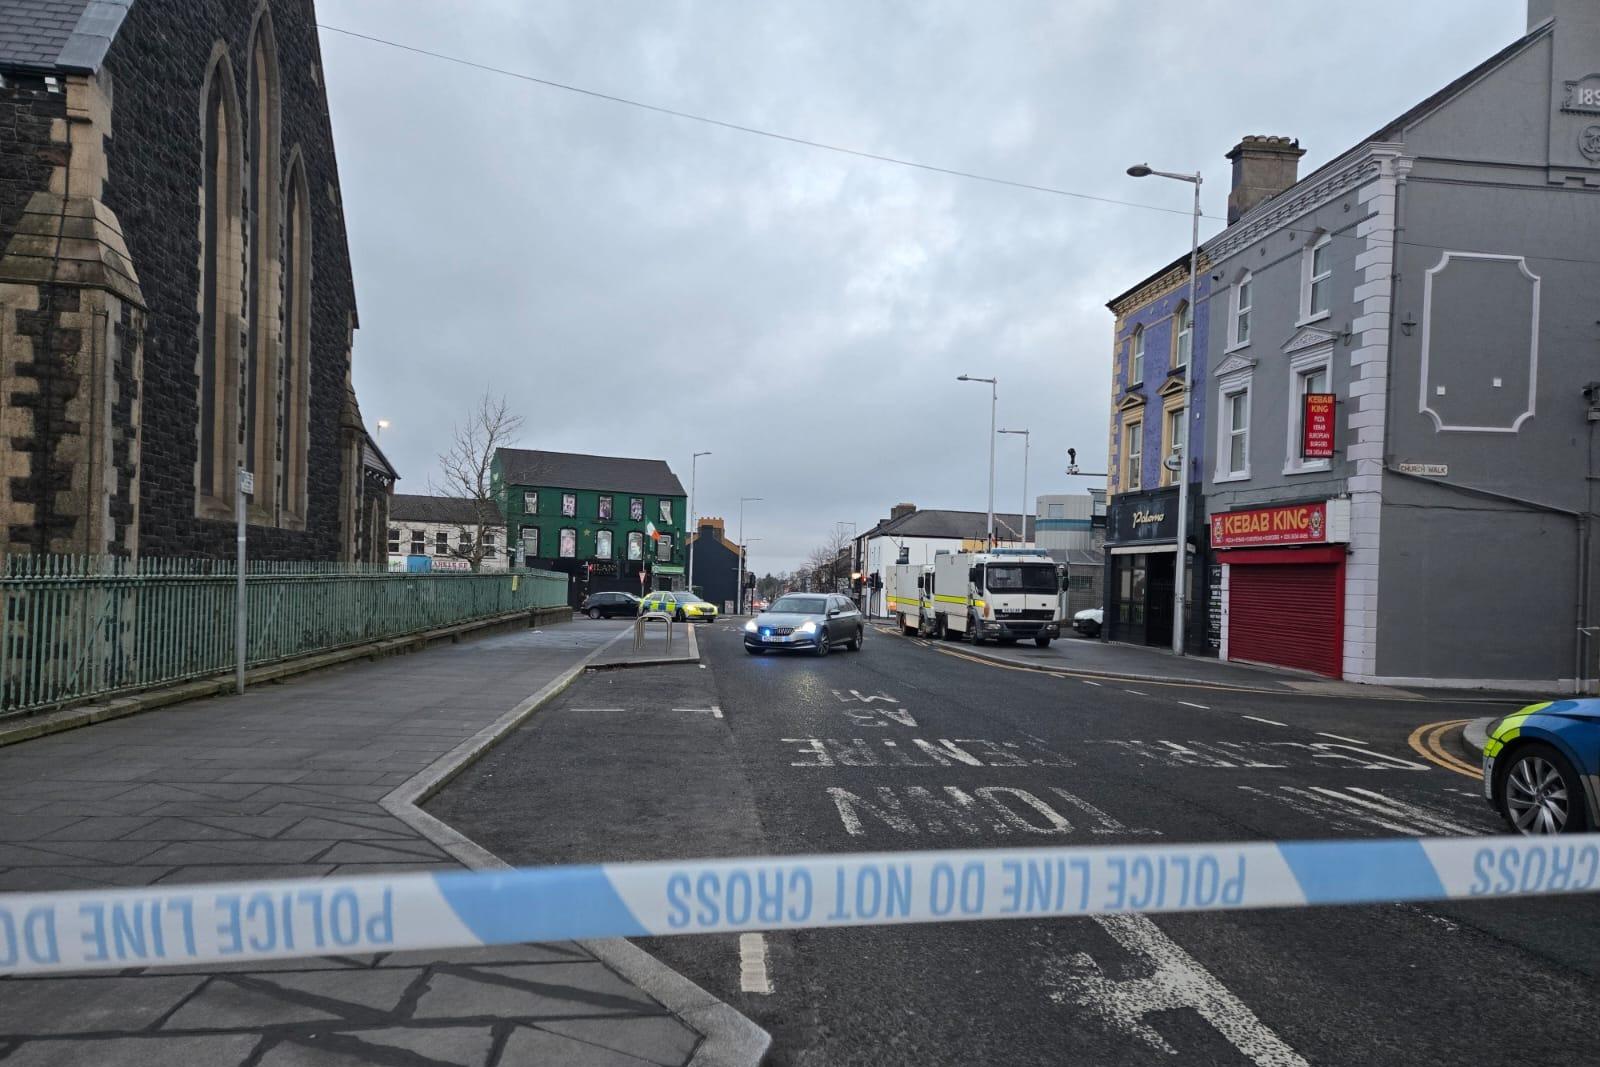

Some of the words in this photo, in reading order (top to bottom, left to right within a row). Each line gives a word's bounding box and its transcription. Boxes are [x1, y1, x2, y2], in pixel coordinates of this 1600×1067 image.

[1308, 395, 1333, 404] KEBAB
[1311, 405, 1329, 413] KING
[1400, 465, 1425, 473] CHURCH
[1428, 466, 1447, 474] WALK
[1225, 513, 1270, 535] KEBAB
[1273, 508, 1309, 531] KING
[666, 866, 814, 929] CROSS
[826, 863, 913, 920] NOT
[929, 860, 986, 916] DO
[1001, 856, 1091, 914] LINE
[1104, 852, 1247, 910] POLICE
[1470, 845, 1600, 897] CROSS
[79, 896, 197, 962] LINE
[216, 886, 394, 956] POLICE
